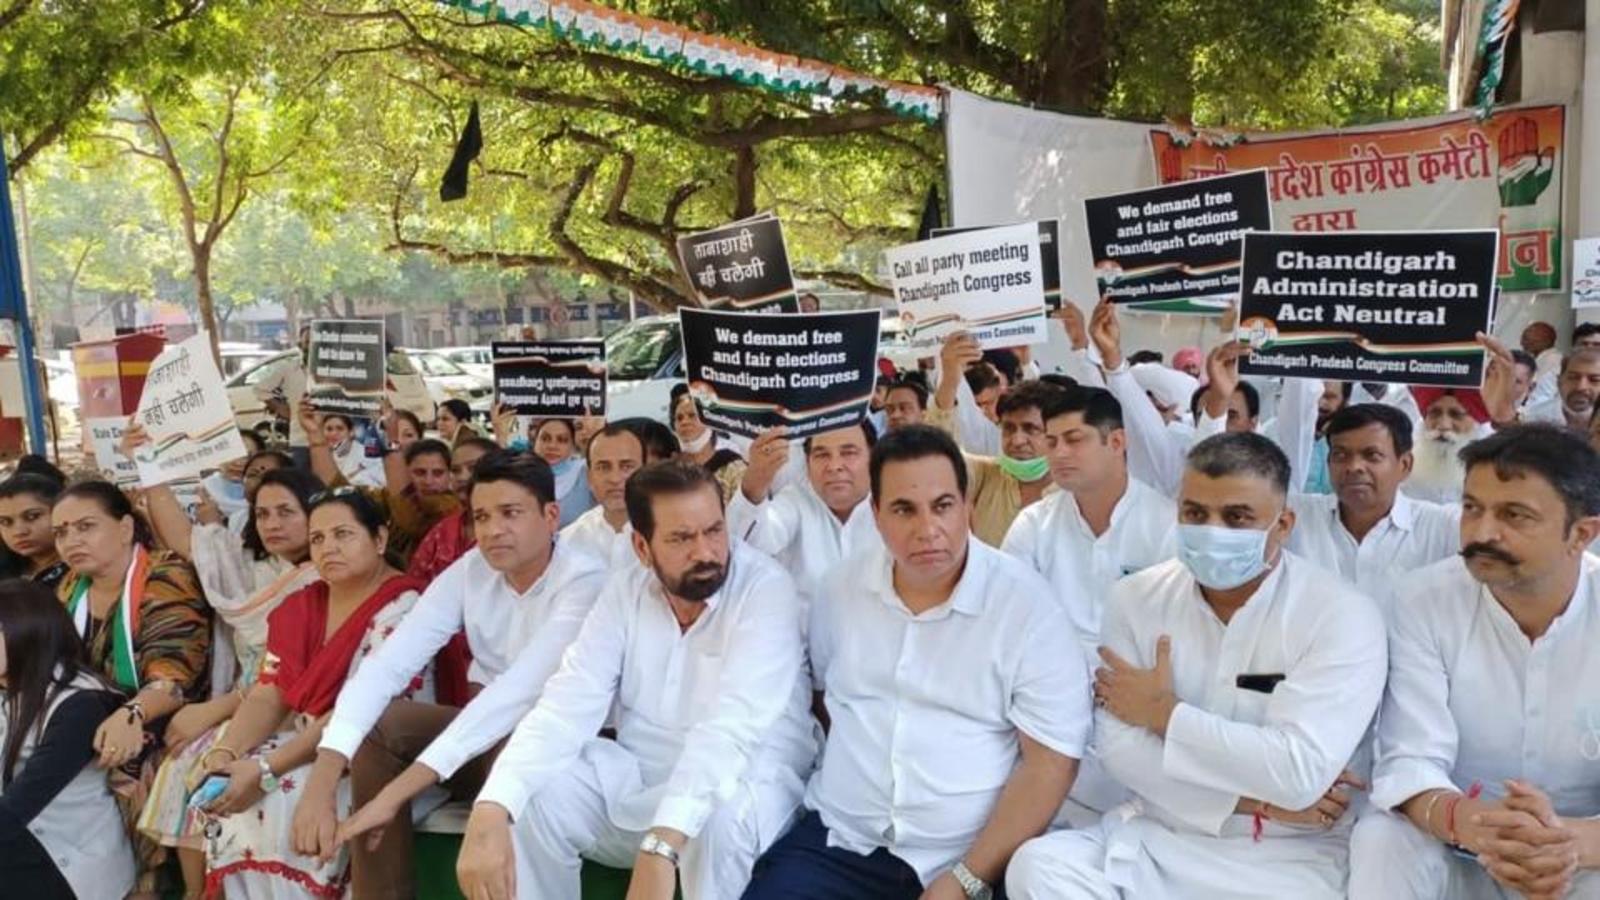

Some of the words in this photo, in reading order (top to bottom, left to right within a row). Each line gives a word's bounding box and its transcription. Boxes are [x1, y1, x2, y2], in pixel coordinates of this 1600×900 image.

[1328, 146, 1411, 194] कांग्रेस
[1416, 131, 1491, 183] कमेटी
[1118, 206, 1140, 220] We
[1143, 195, 1201, 216] demand
[1204, 191, 1233, 206] free
[1117, 224, 1143, 238] and
[1146, 220, 1171, 234] fair
[1173, 209, 1239, 231] elections
[693, 228, 755, 259] तानाशाही
[1105, 236, 1184, 257] Chandigarh
[719, 257, 766, 283] चलेगी
[894, 260, 912, 279] Call
[915, 257, 929, 274] all
[932, 252, 965, 275] party
[969, 242, 1030, 265] meeting
[1276, 251, 1456, 274] Chandigarh
[899, 277, 959, 304] Chandigarh
[963, 270, 1032, 293] Congress
[1252, 277, 1478, 298] Administration
[1277, 303, 1324, 322] Act
[1334, 304, 1447, 326] Neutral
[715, 328, 739, 344] We
[743, 330, 808, 346] demand
[812, 330, 843, 345] free
[713, 350, 741, 365] and
[745, 351, 772, 367] fair
[776, 351, 847, 367] elections
[1249, 353, 1307, 370] Chandigarh
[1310, 355, 1353, 370] Pradesh
[1356, 357, 1406, 374] Congress
[1409, 360, 1470, 375] Committee
[499, 375, 544, 391] Congress
[545, 376, 601, 391] Chandigarh
[701, 365, 785, 391] Chandigarh
[790, 369, 860, 389] Congress
[541, 392, 566, 406] party
